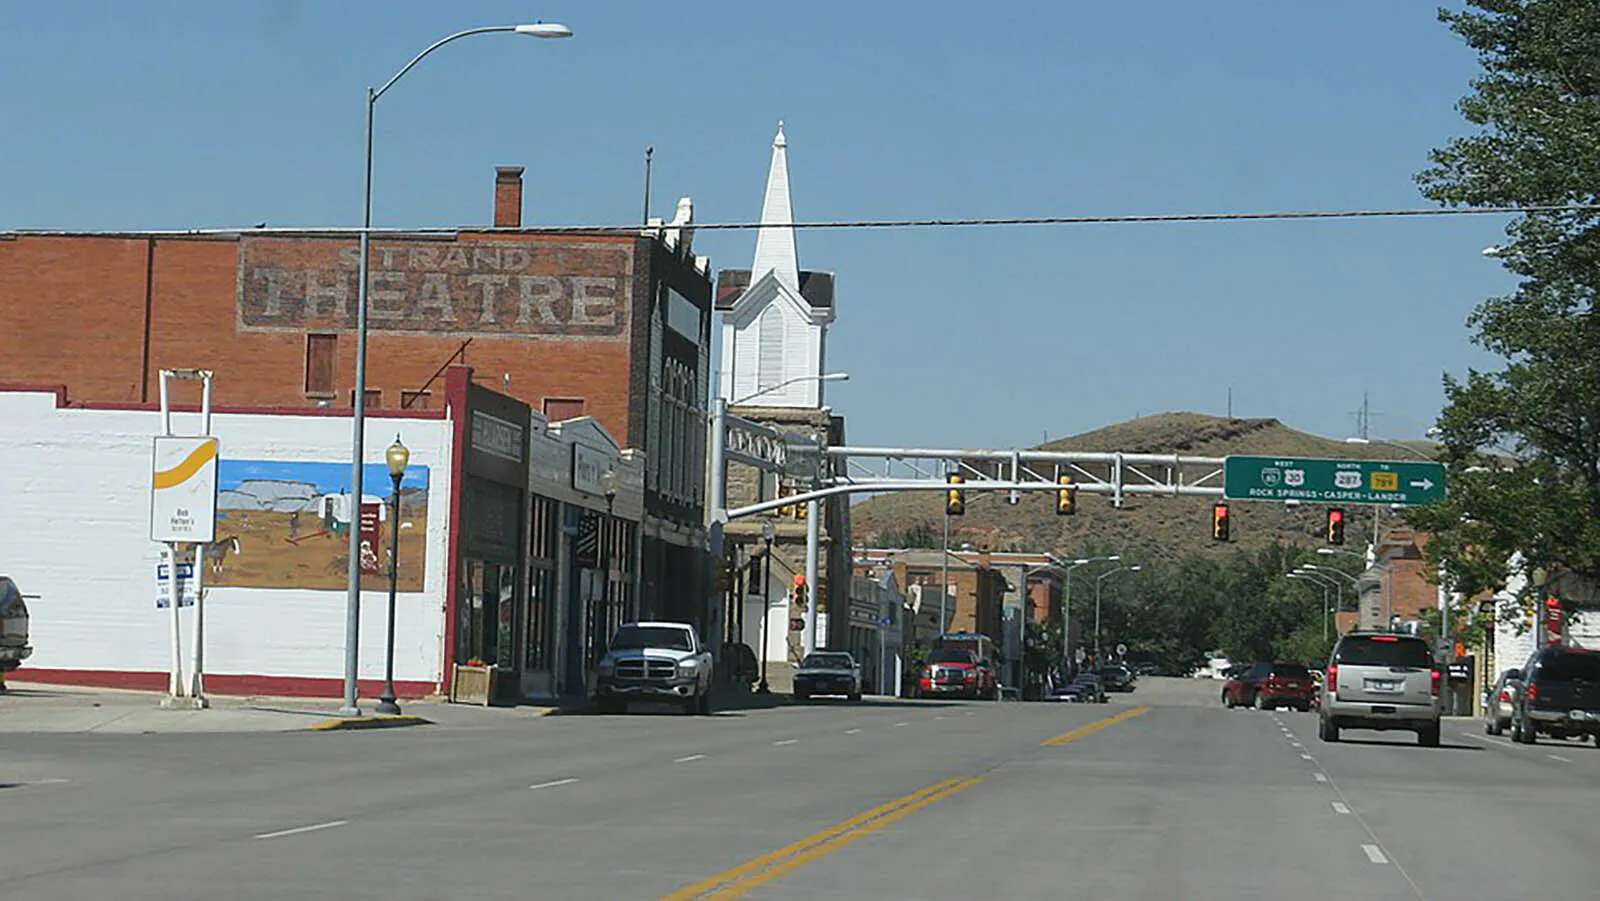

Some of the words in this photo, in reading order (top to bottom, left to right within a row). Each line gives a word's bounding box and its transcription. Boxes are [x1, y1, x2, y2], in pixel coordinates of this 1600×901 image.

[337, 247, 531, 271] STRAND
[254, 267, 616, 326] THEATRE
[1288, 473, 1301, 483] 30
[1339, 475, 1358, 485] 287
[1249, 487, 1273, 496] ROCK
